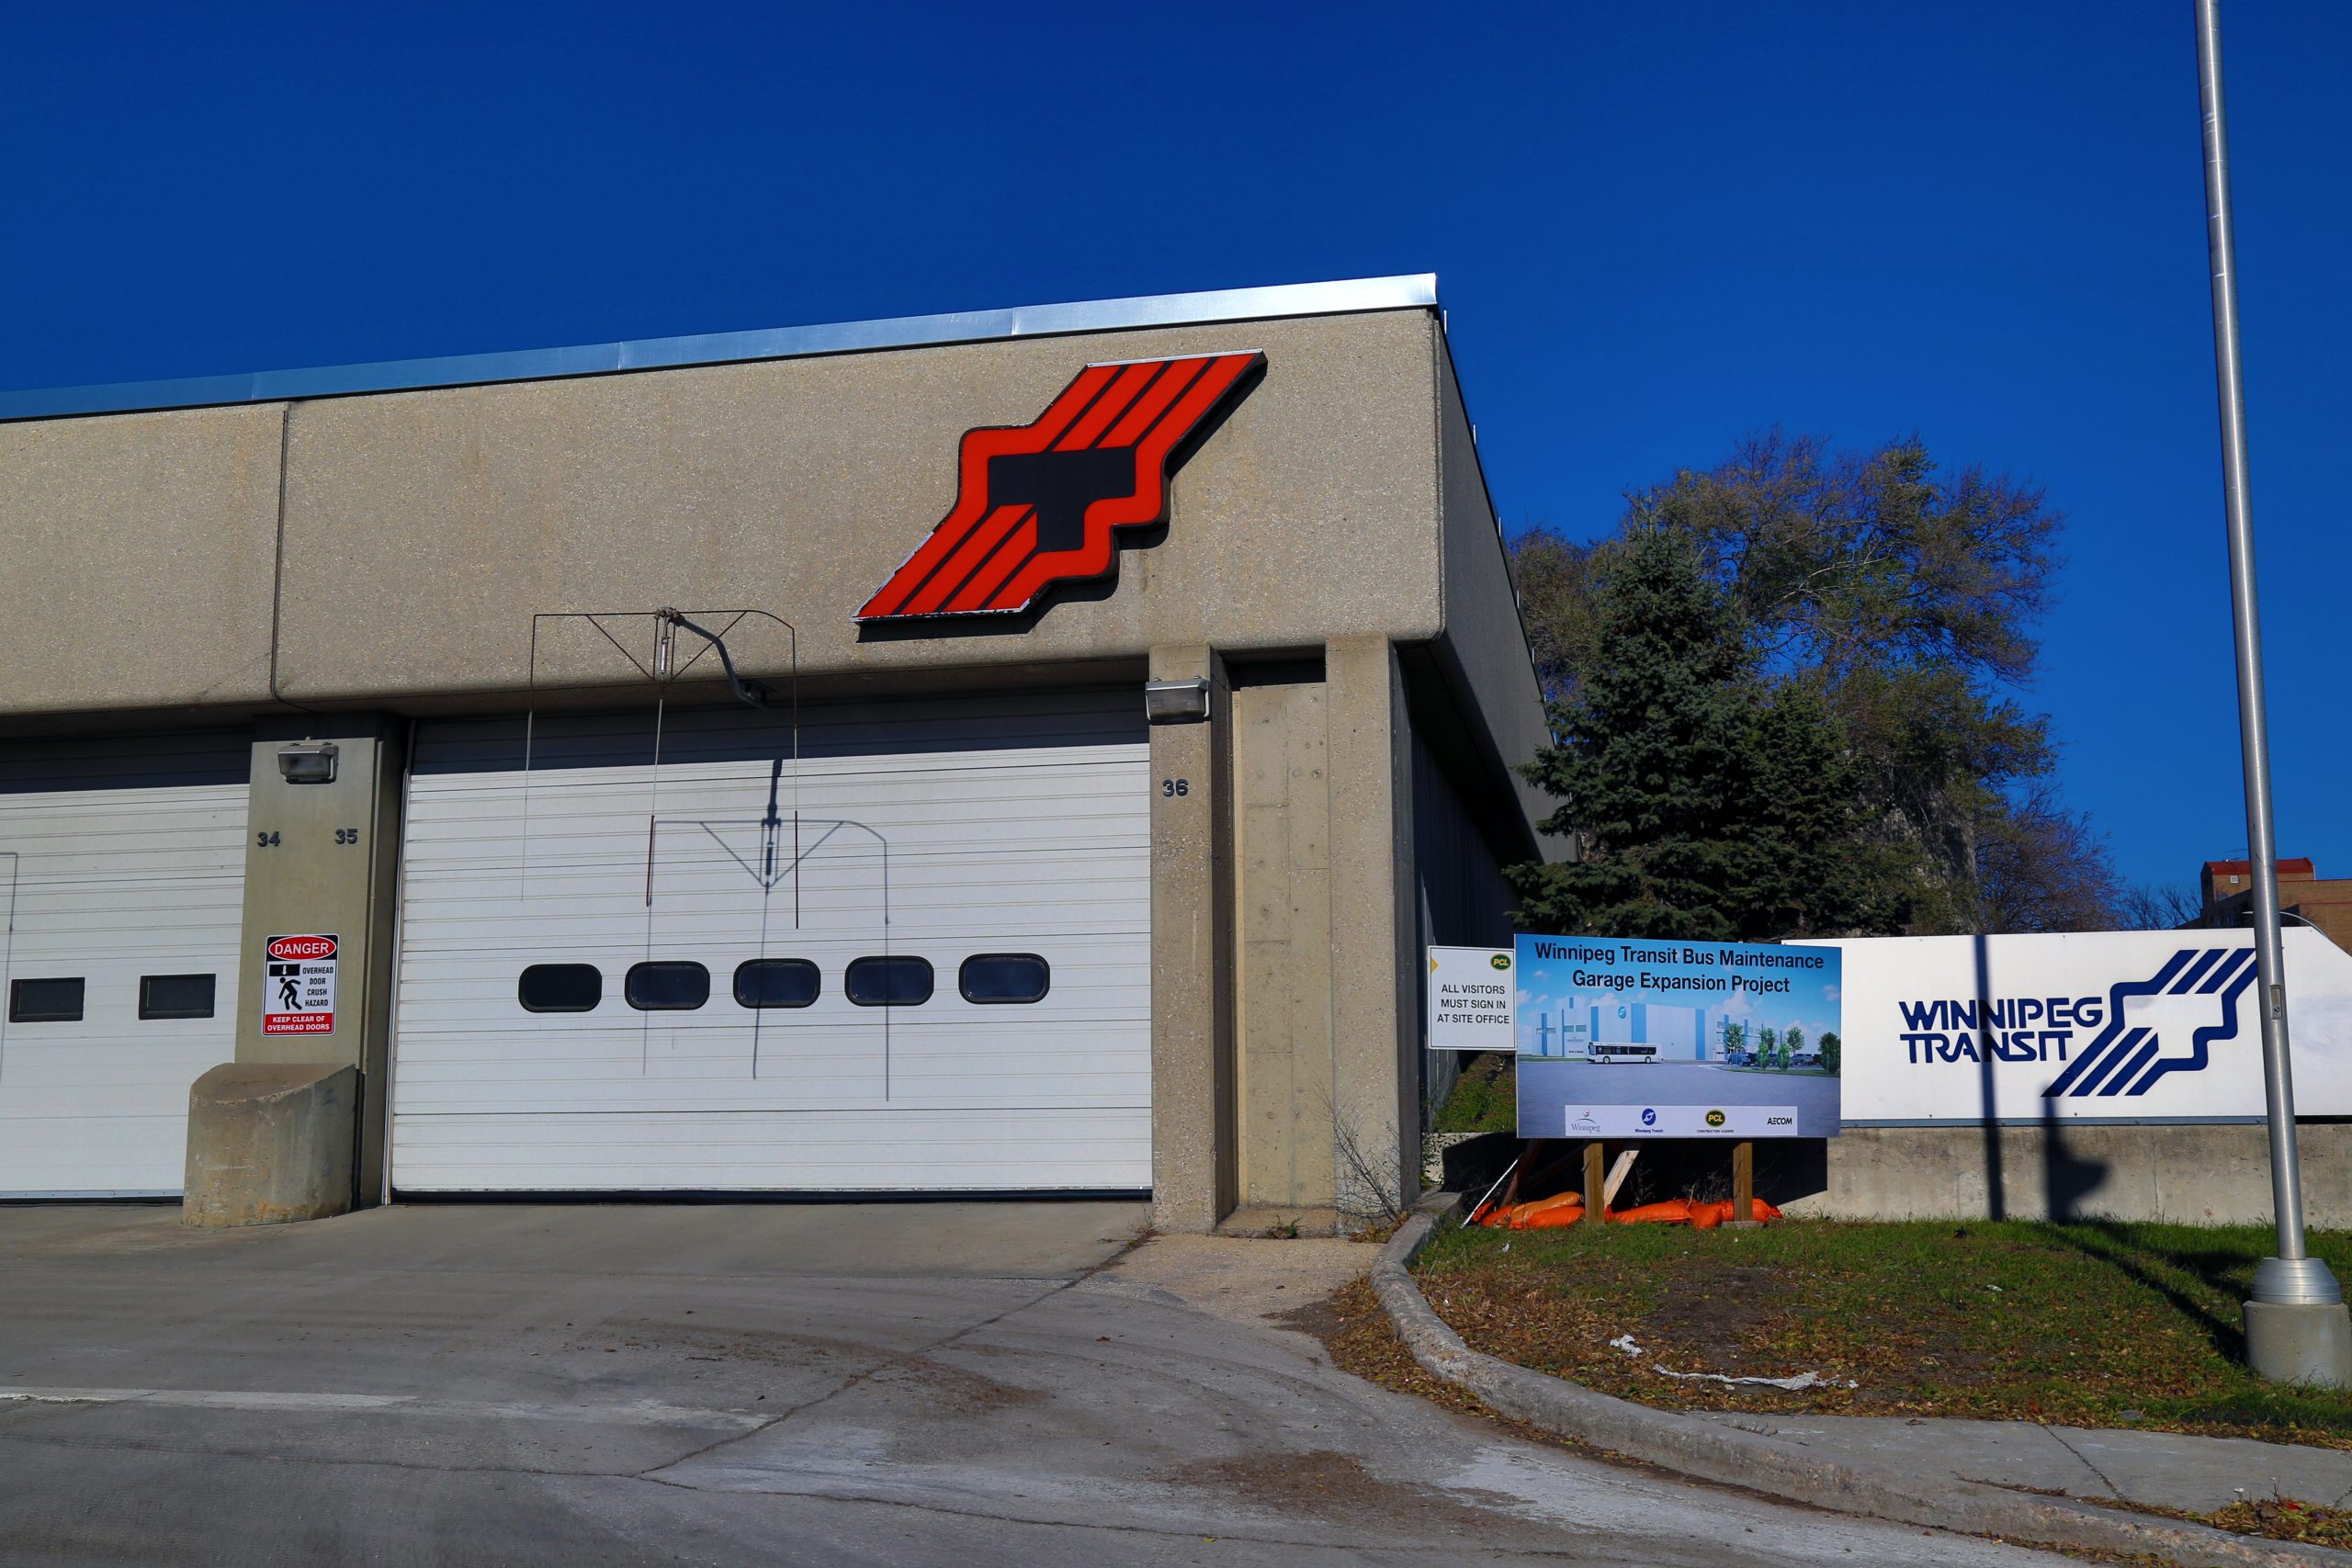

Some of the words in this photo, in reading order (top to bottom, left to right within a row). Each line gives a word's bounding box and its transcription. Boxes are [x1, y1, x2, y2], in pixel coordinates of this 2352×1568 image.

[1163, 778, 1188, 797] 36
[256, 831, 281, 847] 34
[334, 829, 358, 845] 35
[275, 943, 329, 954] DANGER
[1534, 942, 1615, 964] Winnipeg
[1620, 946, 1678, 964] Transit
[1683, 948, 1714, 965] Bus
[1719, 949, 1824, 969] Maintenance
[1441, 984, 1459, 993] ALL
[1462, 985, 1505, 994] VISITORS
[1572, 970, 1635, 992] Garage
[1640, 972, 1726, 993] Expansion
[1731, 975, 1790, 995] Project
[1441, 999, 1469, 1008] MUST
[1471, 1000, 1493, 1009] SIGN
[1496, 1000, 1506, 1009] IN
[1437, 1014, 1449, 1022] AT
[1452, 1014, 1473, 1023] SITE
[1476, 1015, 1510, 1024] OFFICE
[1898, 997, 2103, 1030] WINNIPEG
[1900, 1030, 2073, 1064] TRANSIT
[1572, 1123, 1600, 1133] Winnipeg
